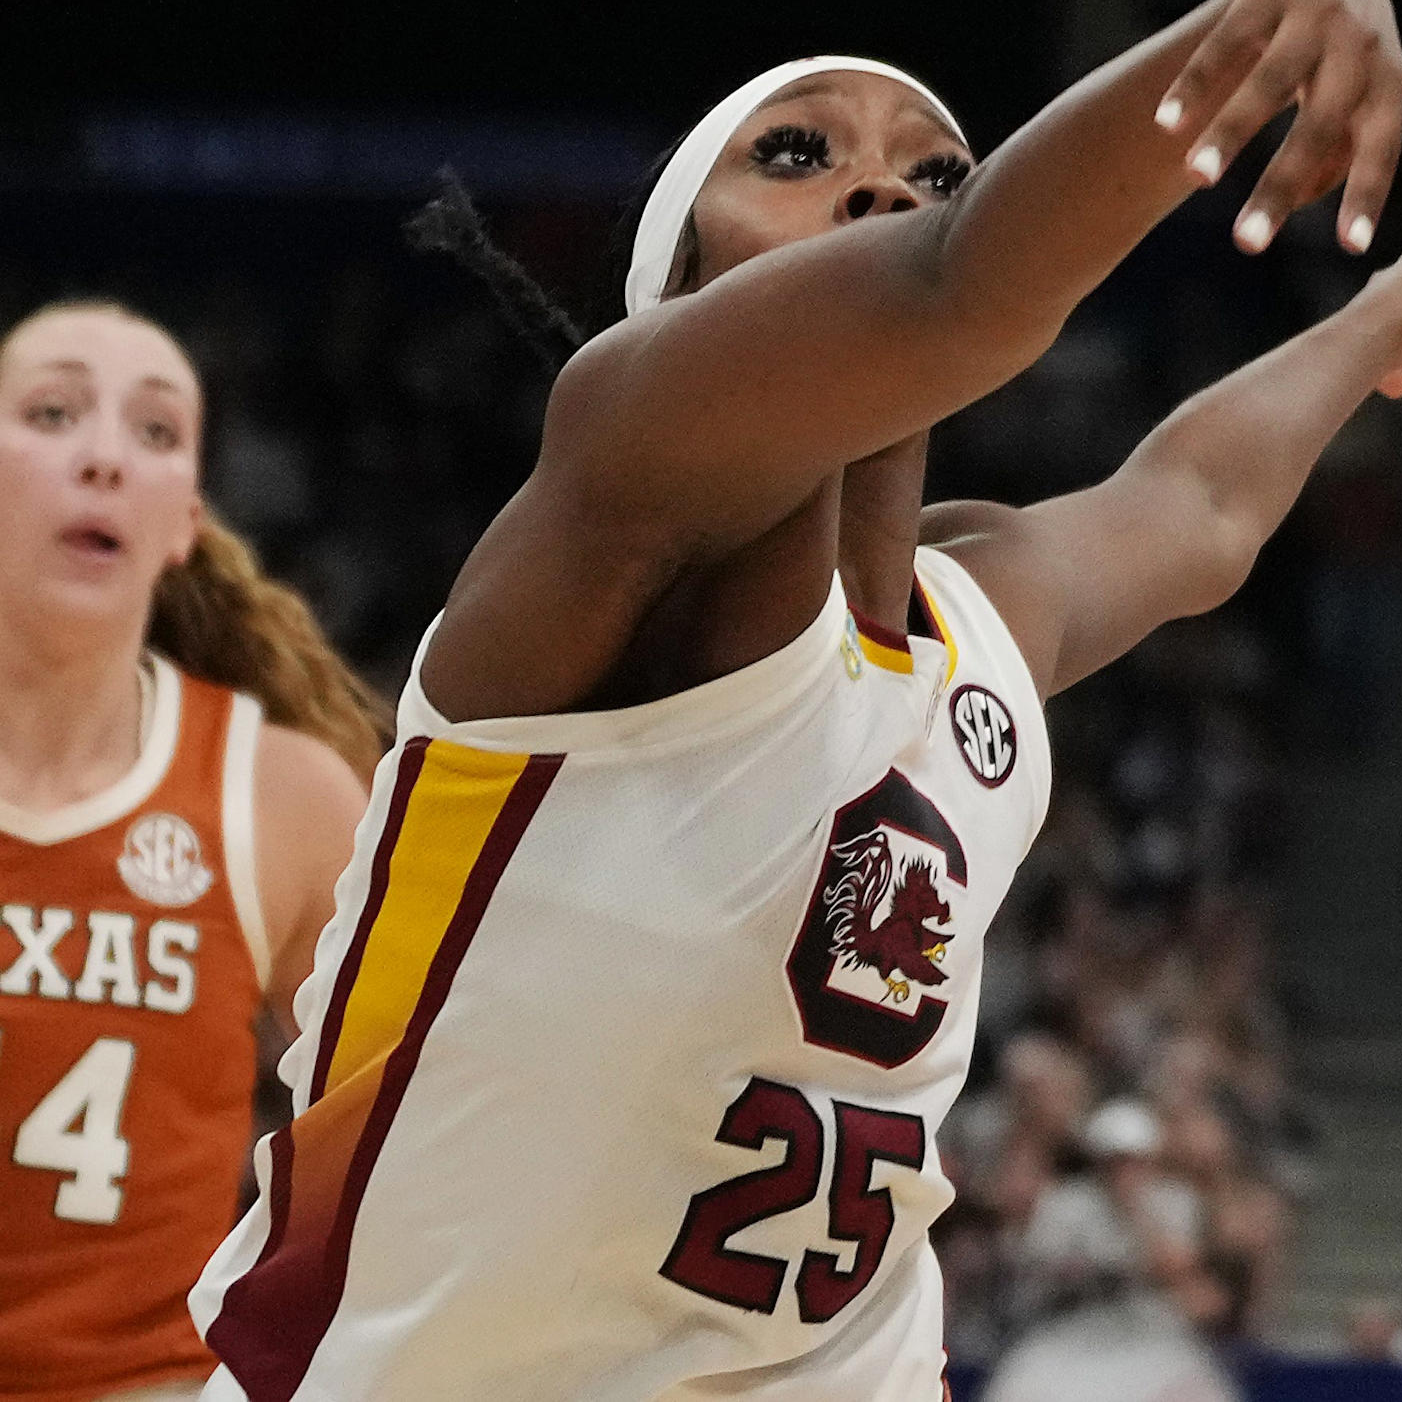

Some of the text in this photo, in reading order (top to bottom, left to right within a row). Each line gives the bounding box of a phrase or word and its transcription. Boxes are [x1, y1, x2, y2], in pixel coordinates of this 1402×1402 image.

[953, 690, 1013, 779] SEC
[0, 903, 200, 1015] XAS
[0, 1034, 136, 1225] 4
[658, 1075, 925, 1324] 25
